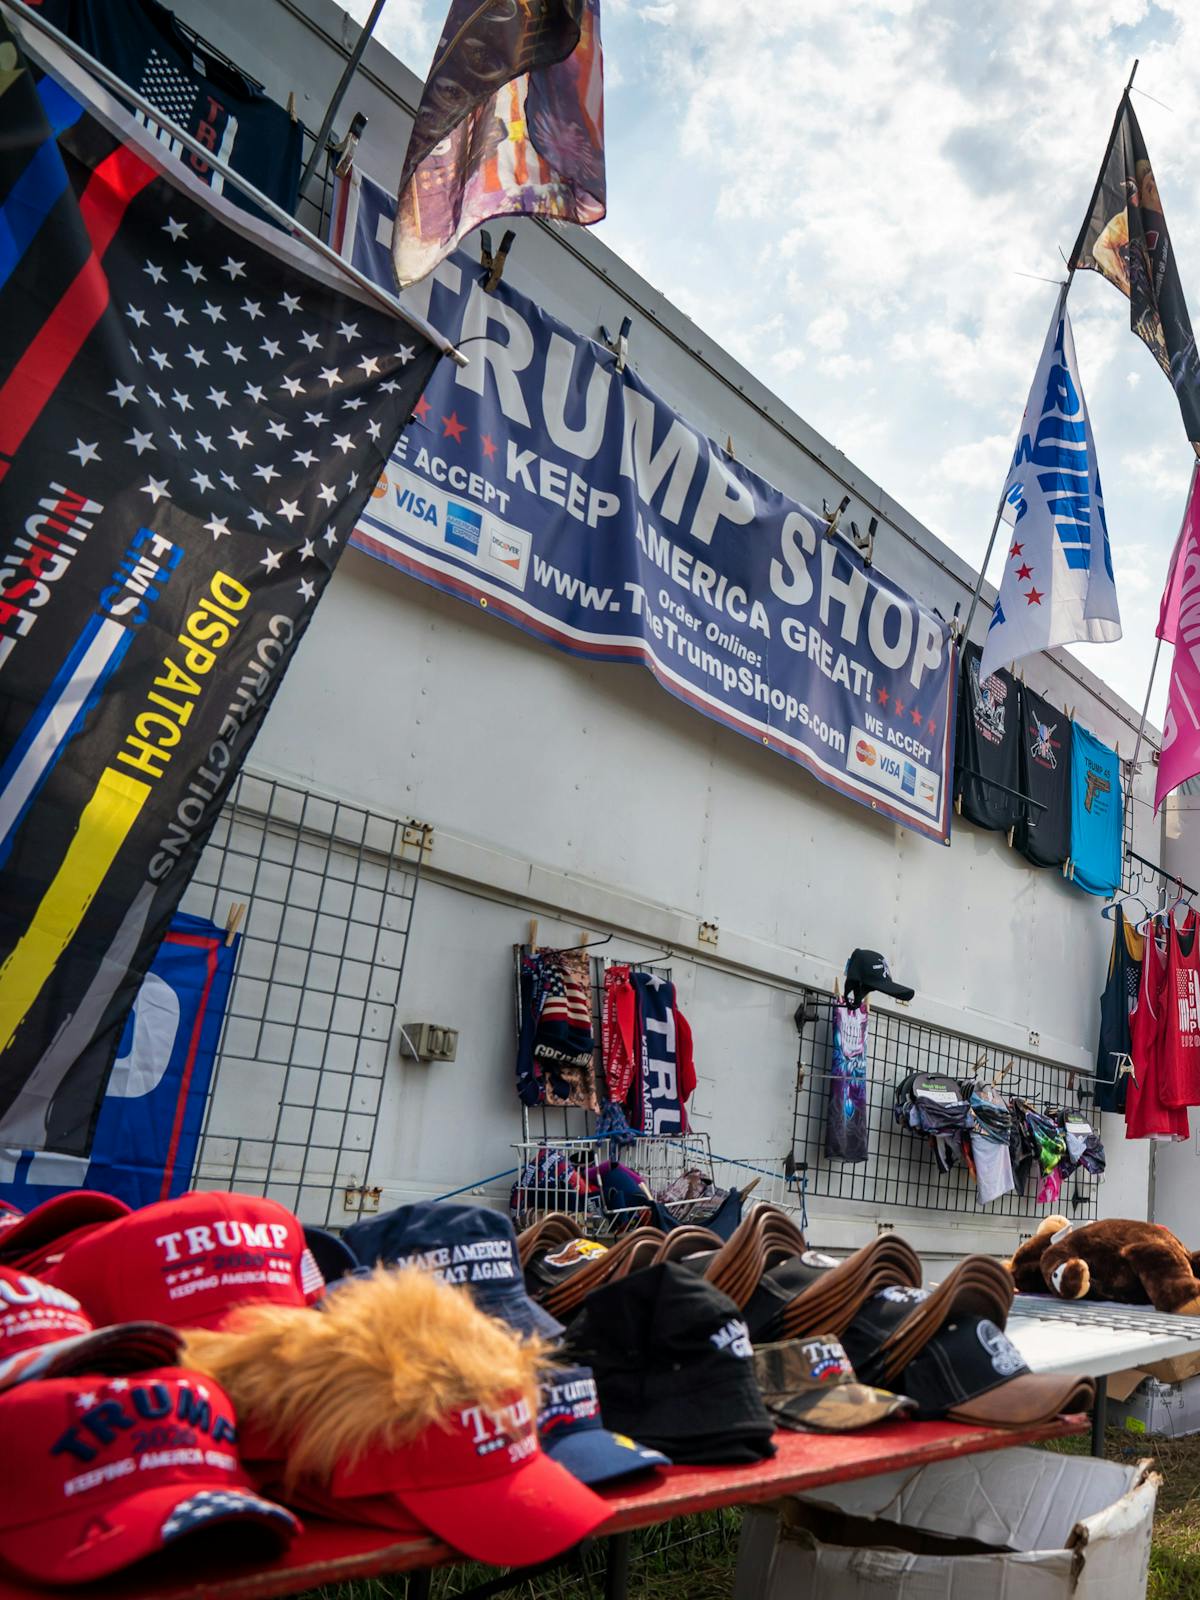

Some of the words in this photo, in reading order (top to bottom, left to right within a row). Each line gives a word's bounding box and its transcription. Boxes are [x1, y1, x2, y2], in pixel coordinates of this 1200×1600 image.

[393, 482, 438, 528] VISA
[414, 447, 511, 515] ACCEPT
[101, 527, 185, 625] EMS
[506, 438, 621, 529] KEEP
[634, 511, 771, 640] AMERICA
[780, 617, 875, 703] GREAT!
[770, 511, 943, 690] SHOP
[658, 589, 702, 633] Order
[705, 621, 763, 668] Online:
[116, 570, 252, 778] DISPATCH
[864, 712, 884, 738] WE
[887, 727, 932, 765] ACCEPT
[880, 754, 901, 780] VISA
[1187, 968, 1198, 1034] TRUMP
[156, 1220, 288, 1262] TRUMP
[51, 1384, 237, 1463] TRUMP
